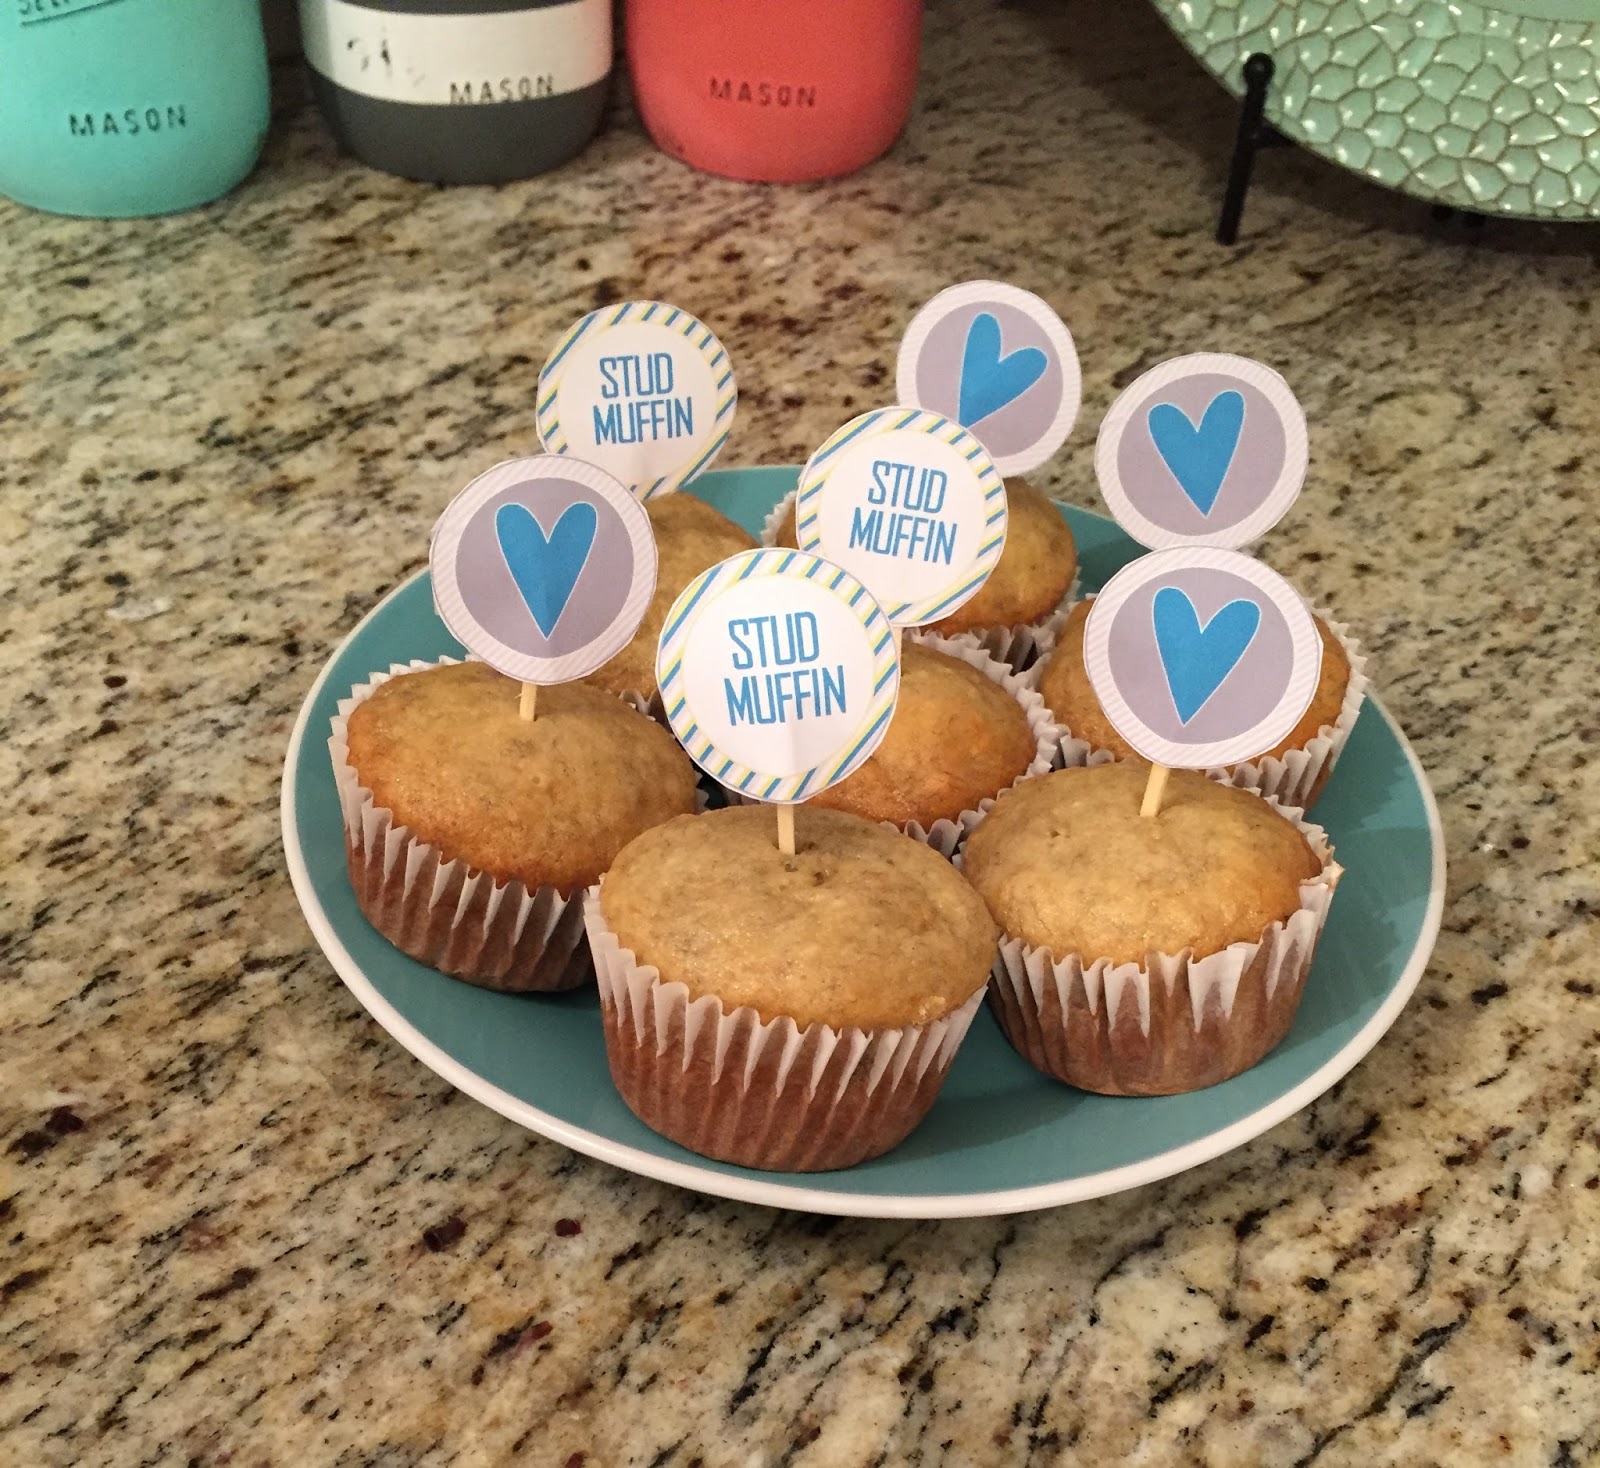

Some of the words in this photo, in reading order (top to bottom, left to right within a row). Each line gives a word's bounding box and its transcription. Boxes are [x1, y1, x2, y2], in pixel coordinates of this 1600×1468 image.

[449, 74, 554, 106] MASON
[709, 77, 817, 108] MASON
[69, 104, 187, 136] MASON
[600, 352, 673, 399] STUD
[593, 397, 693, 445] MUFFIN
[868, 460, 948, 514] STUD
[849, 507, 958, 565] MUFFIN
[728, 611, 820, 670] STUD
[724, 665, 847, 726] MUFFIN
